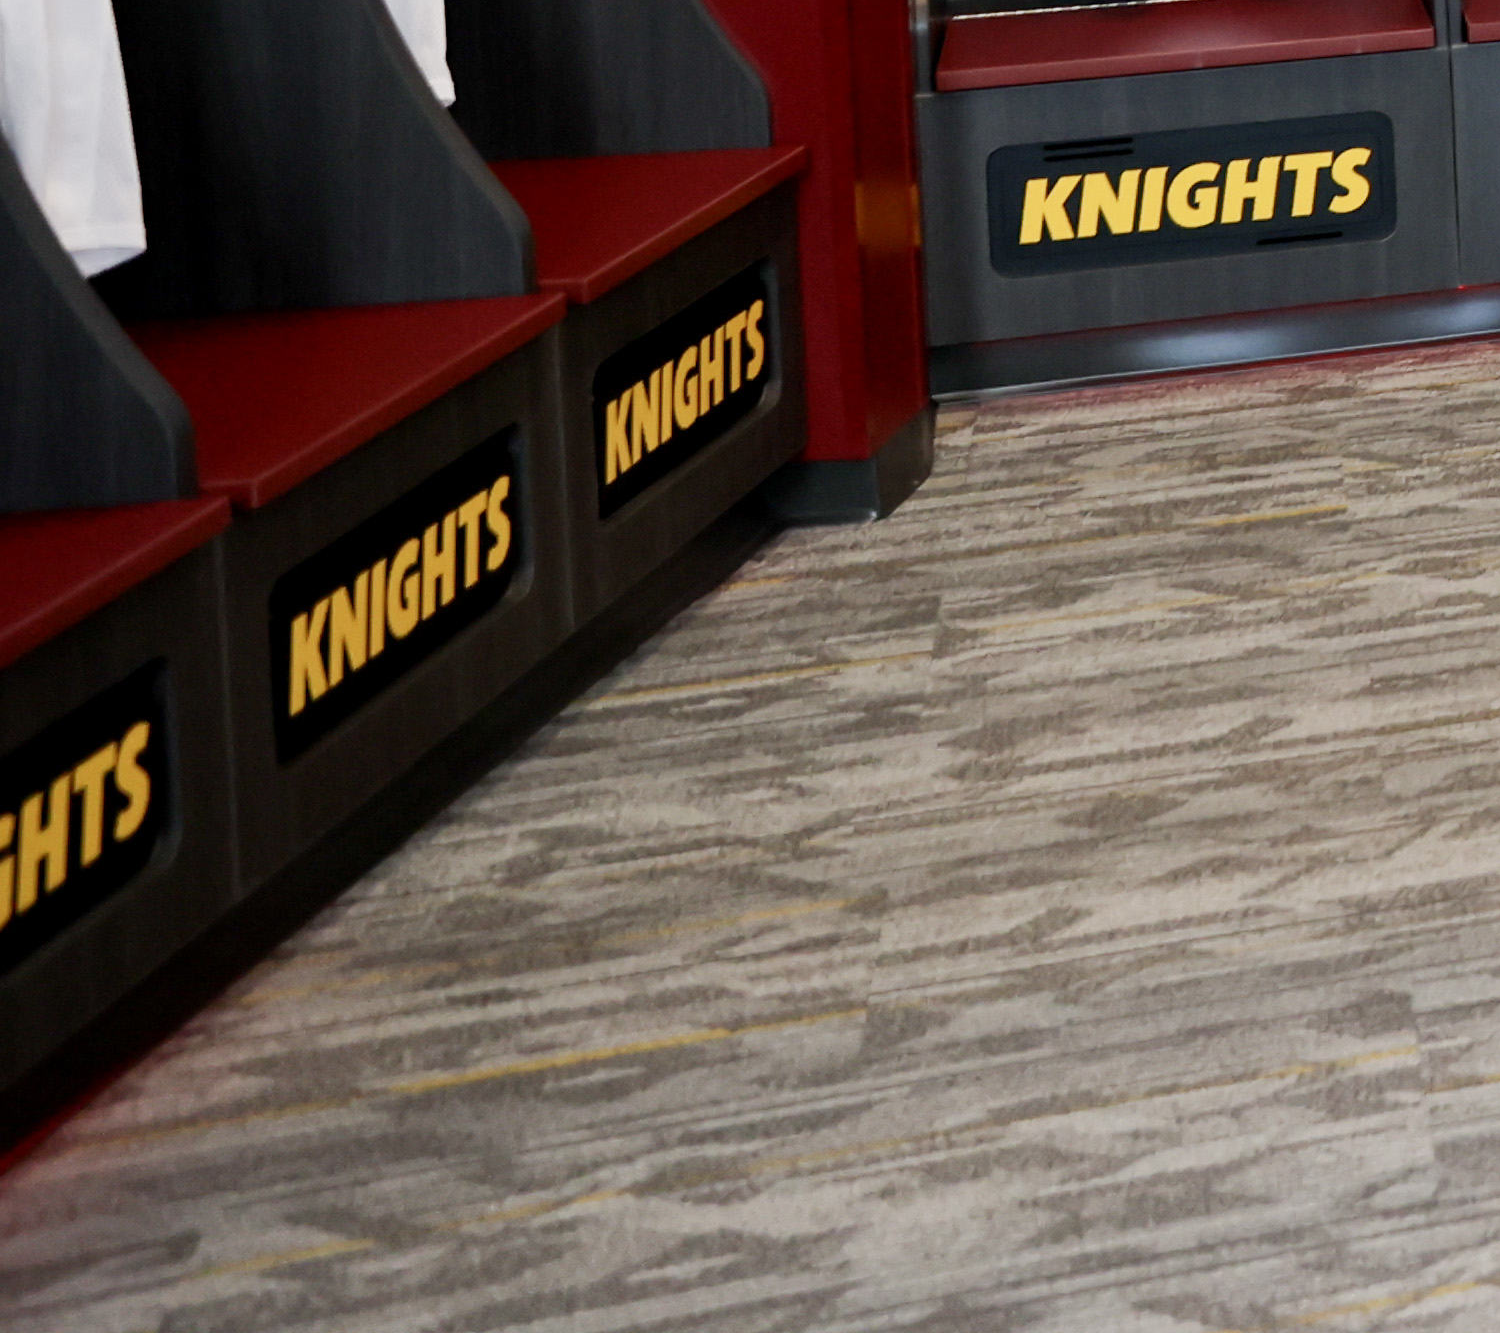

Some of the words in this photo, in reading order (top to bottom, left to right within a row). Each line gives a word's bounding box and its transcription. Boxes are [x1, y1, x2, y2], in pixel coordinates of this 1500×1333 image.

[1019, 148, 1371, 245] KNIGHTS
[606, 298, 765, 486] KNIGHTS
[289, 475, 512, 717] KNIGHTS
